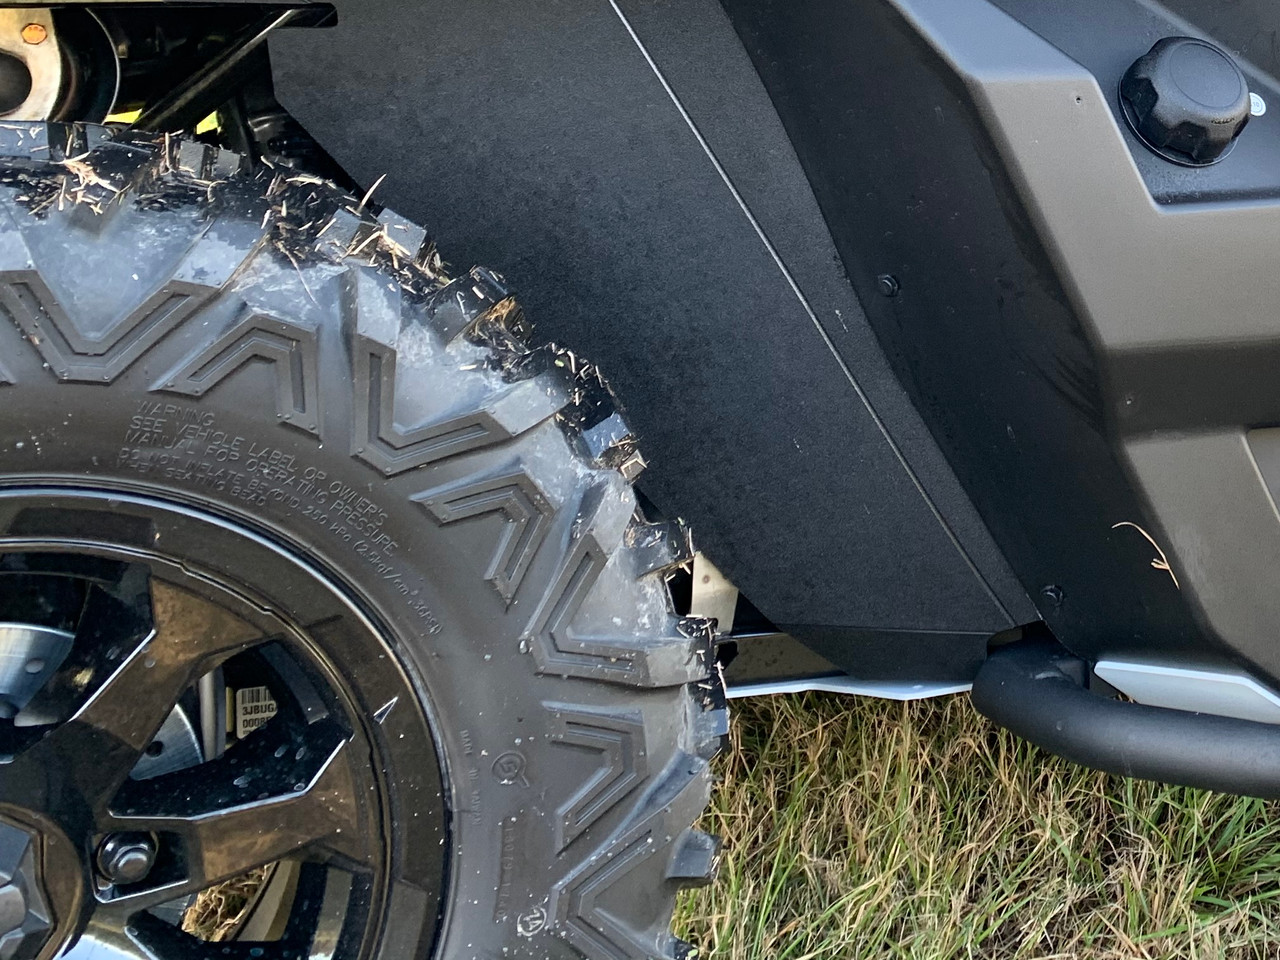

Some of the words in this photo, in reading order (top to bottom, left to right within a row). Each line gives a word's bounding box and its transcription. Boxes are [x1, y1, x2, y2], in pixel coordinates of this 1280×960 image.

[137, 401, 215, 426] WARNING
[119, 447, 140, 460] DO
[148, 452, 181, 465] NOT
[185, 459, 245, 484] INFLATE
[302, 505, 328, 525] 250
[124, 429, 195, 455] MANUAL
[204, 445, 241, 462] FOR
[245, 458, 328, 504] OPERATING
[130, 415, 167, 432] SEE
[176, 422, 245, 451] VEHICLE
[248, 442, 299, 472] LABEL
[303, 466, 327, 482] OR
[329, 481, 389, 527] OWNER'S
[165, 467, 226, 491] SEATING
[230, 485, 267, 506] BEAD
